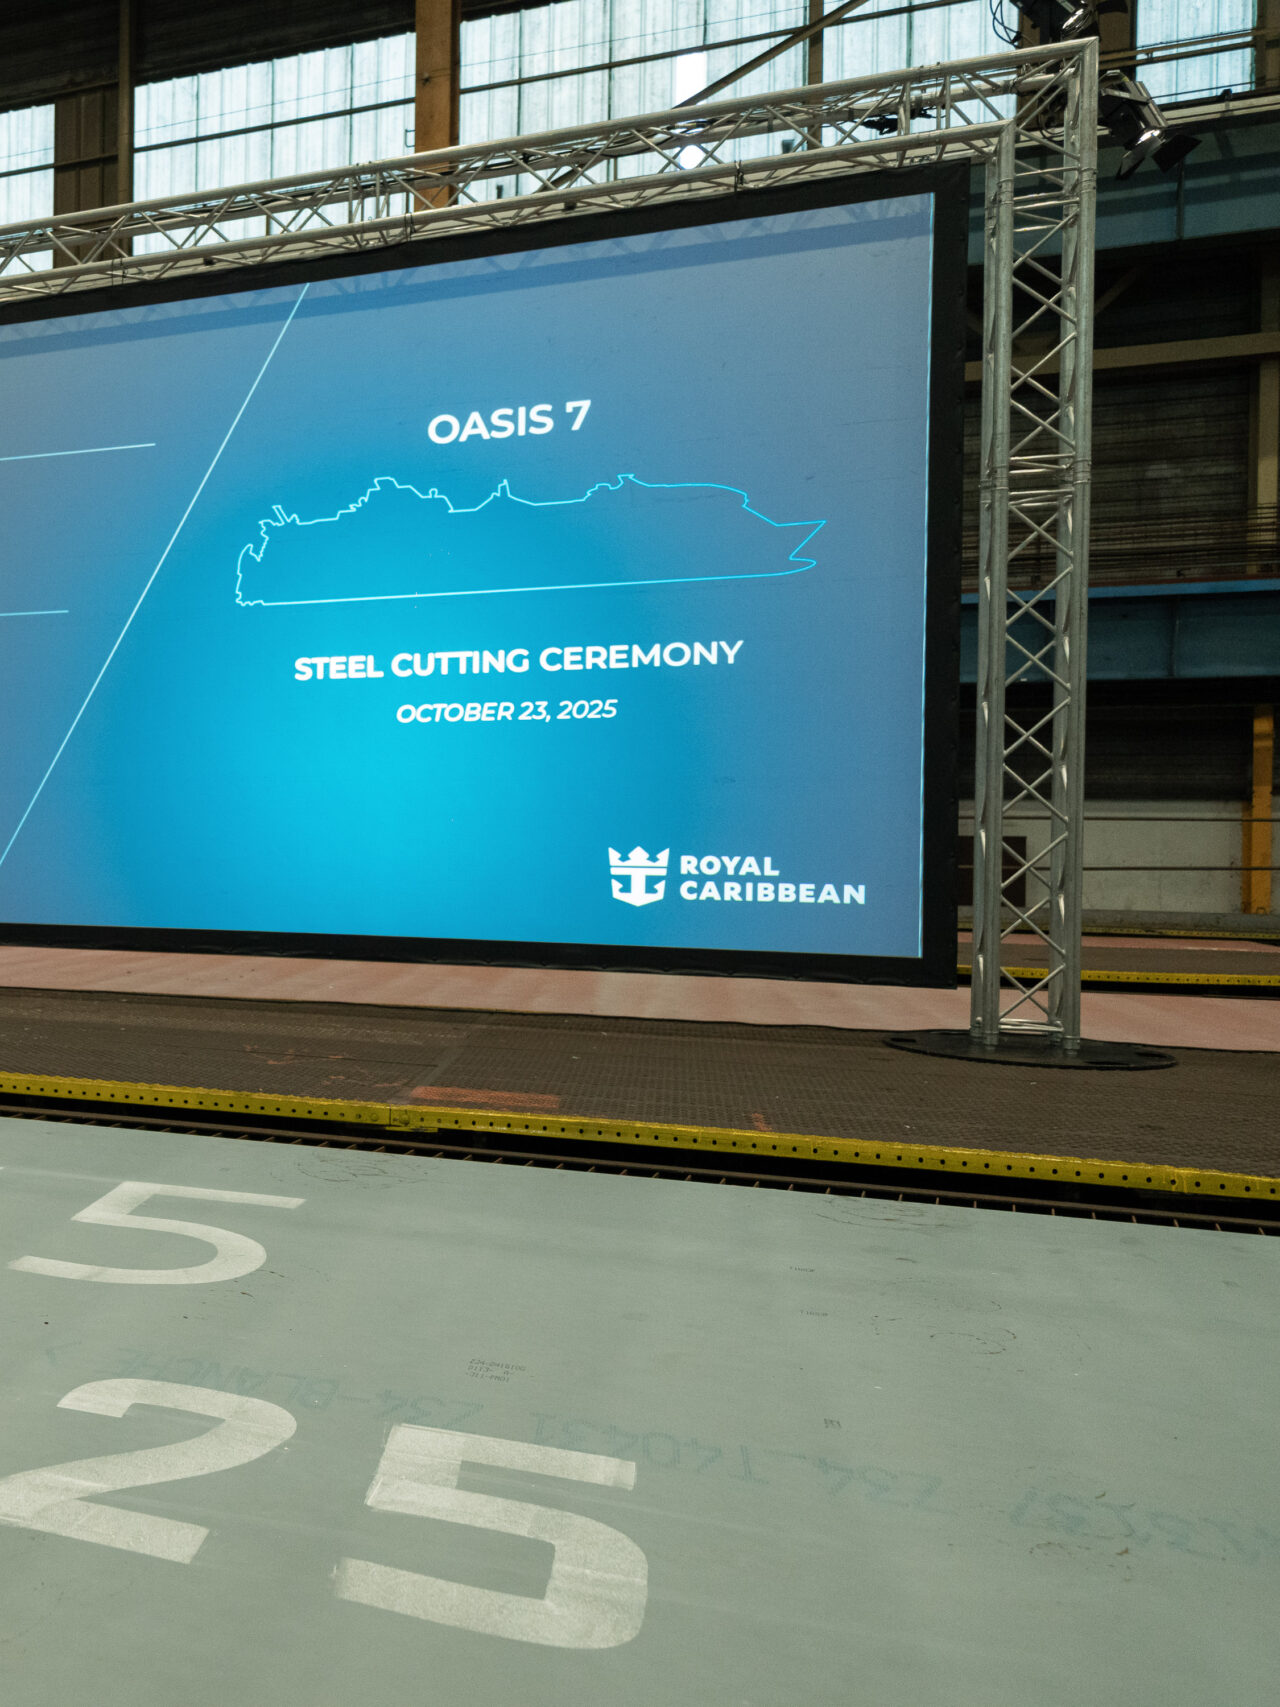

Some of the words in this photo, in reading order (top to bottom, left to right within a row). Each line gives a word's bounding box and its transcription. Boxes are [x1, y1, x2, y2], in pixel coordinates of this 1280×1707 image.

[427, 402, 554, 444] OASIS
[564, 399, 592, 432] 7
[294, 654, 384, 682] STEEL
[391, 648, 530, 678] CUTTING
[539, 640, 744, 672] CEREMONY
[396, 701, 515, 724] OCTOBER
[519, 701, 552, 724] 23,
[558, 699, 618, 721] 2025
[680, 855, 780, 876] ROYAL
[679, 880, 866, 905] CARIBBEAN
